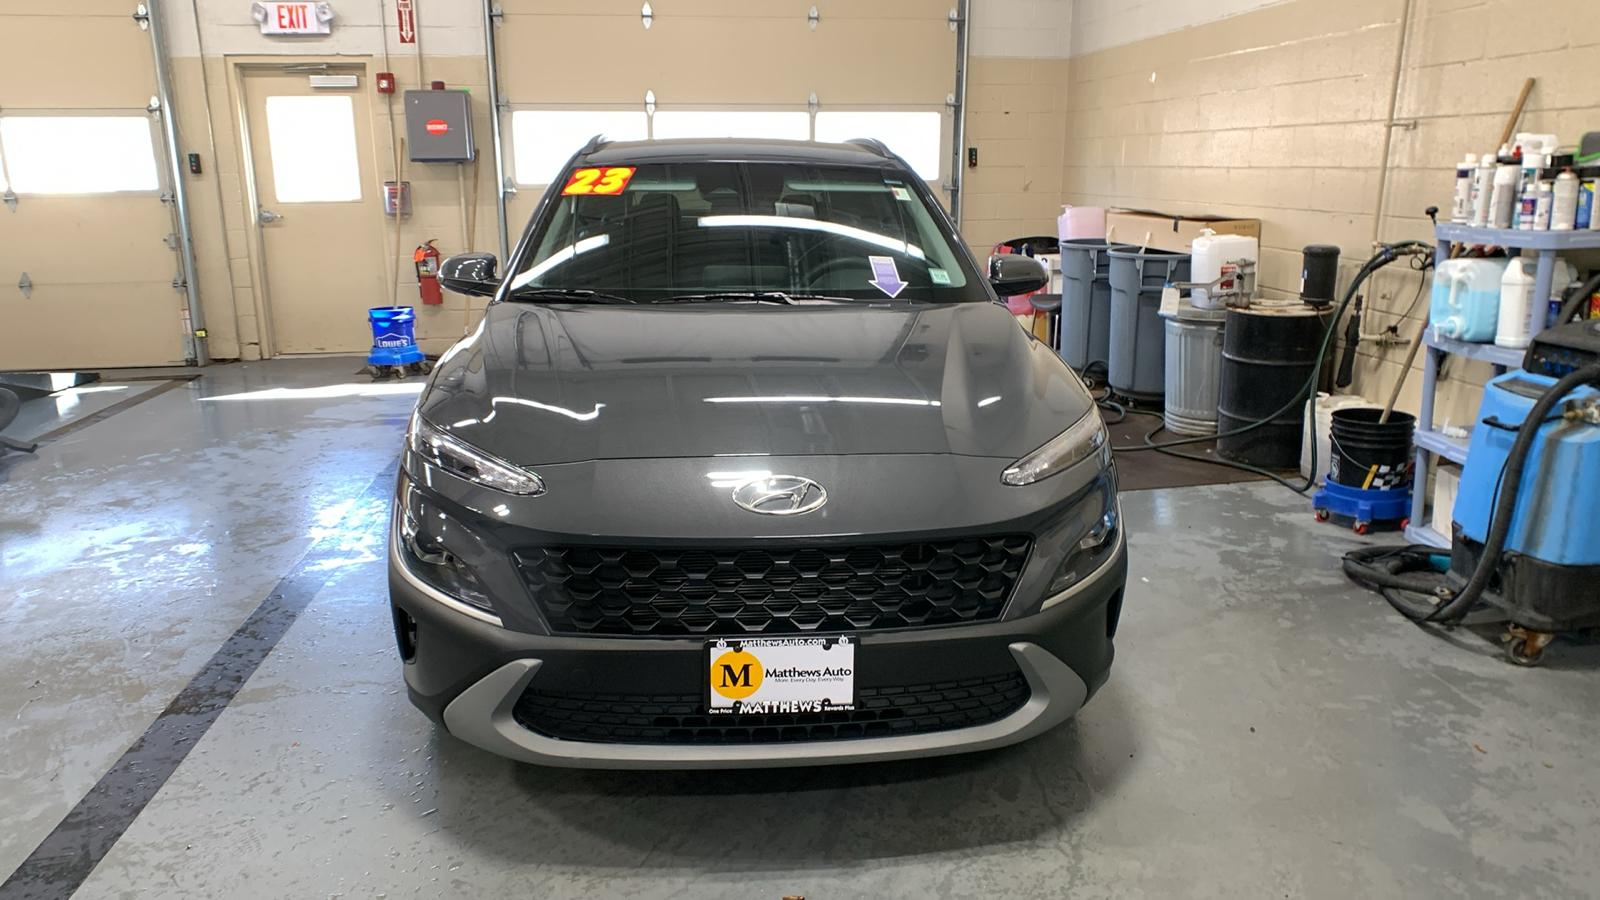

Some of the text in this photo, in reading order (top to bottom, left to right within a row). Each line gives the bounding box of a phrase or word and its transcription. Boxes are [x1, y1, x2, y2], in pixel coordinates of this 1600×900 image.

[277, 5, 307, 29] EXIT
[564, 167, 632, 194] 23
[377, 339, 408, 348] LOWE'S
[740, 638, 827, 648] MatthewsAuto.com
[718, 663, 754, 688] M
[765, 667, 852, 678] Matthews Auto
[739, 699, 822, 714] MATTHEWS
